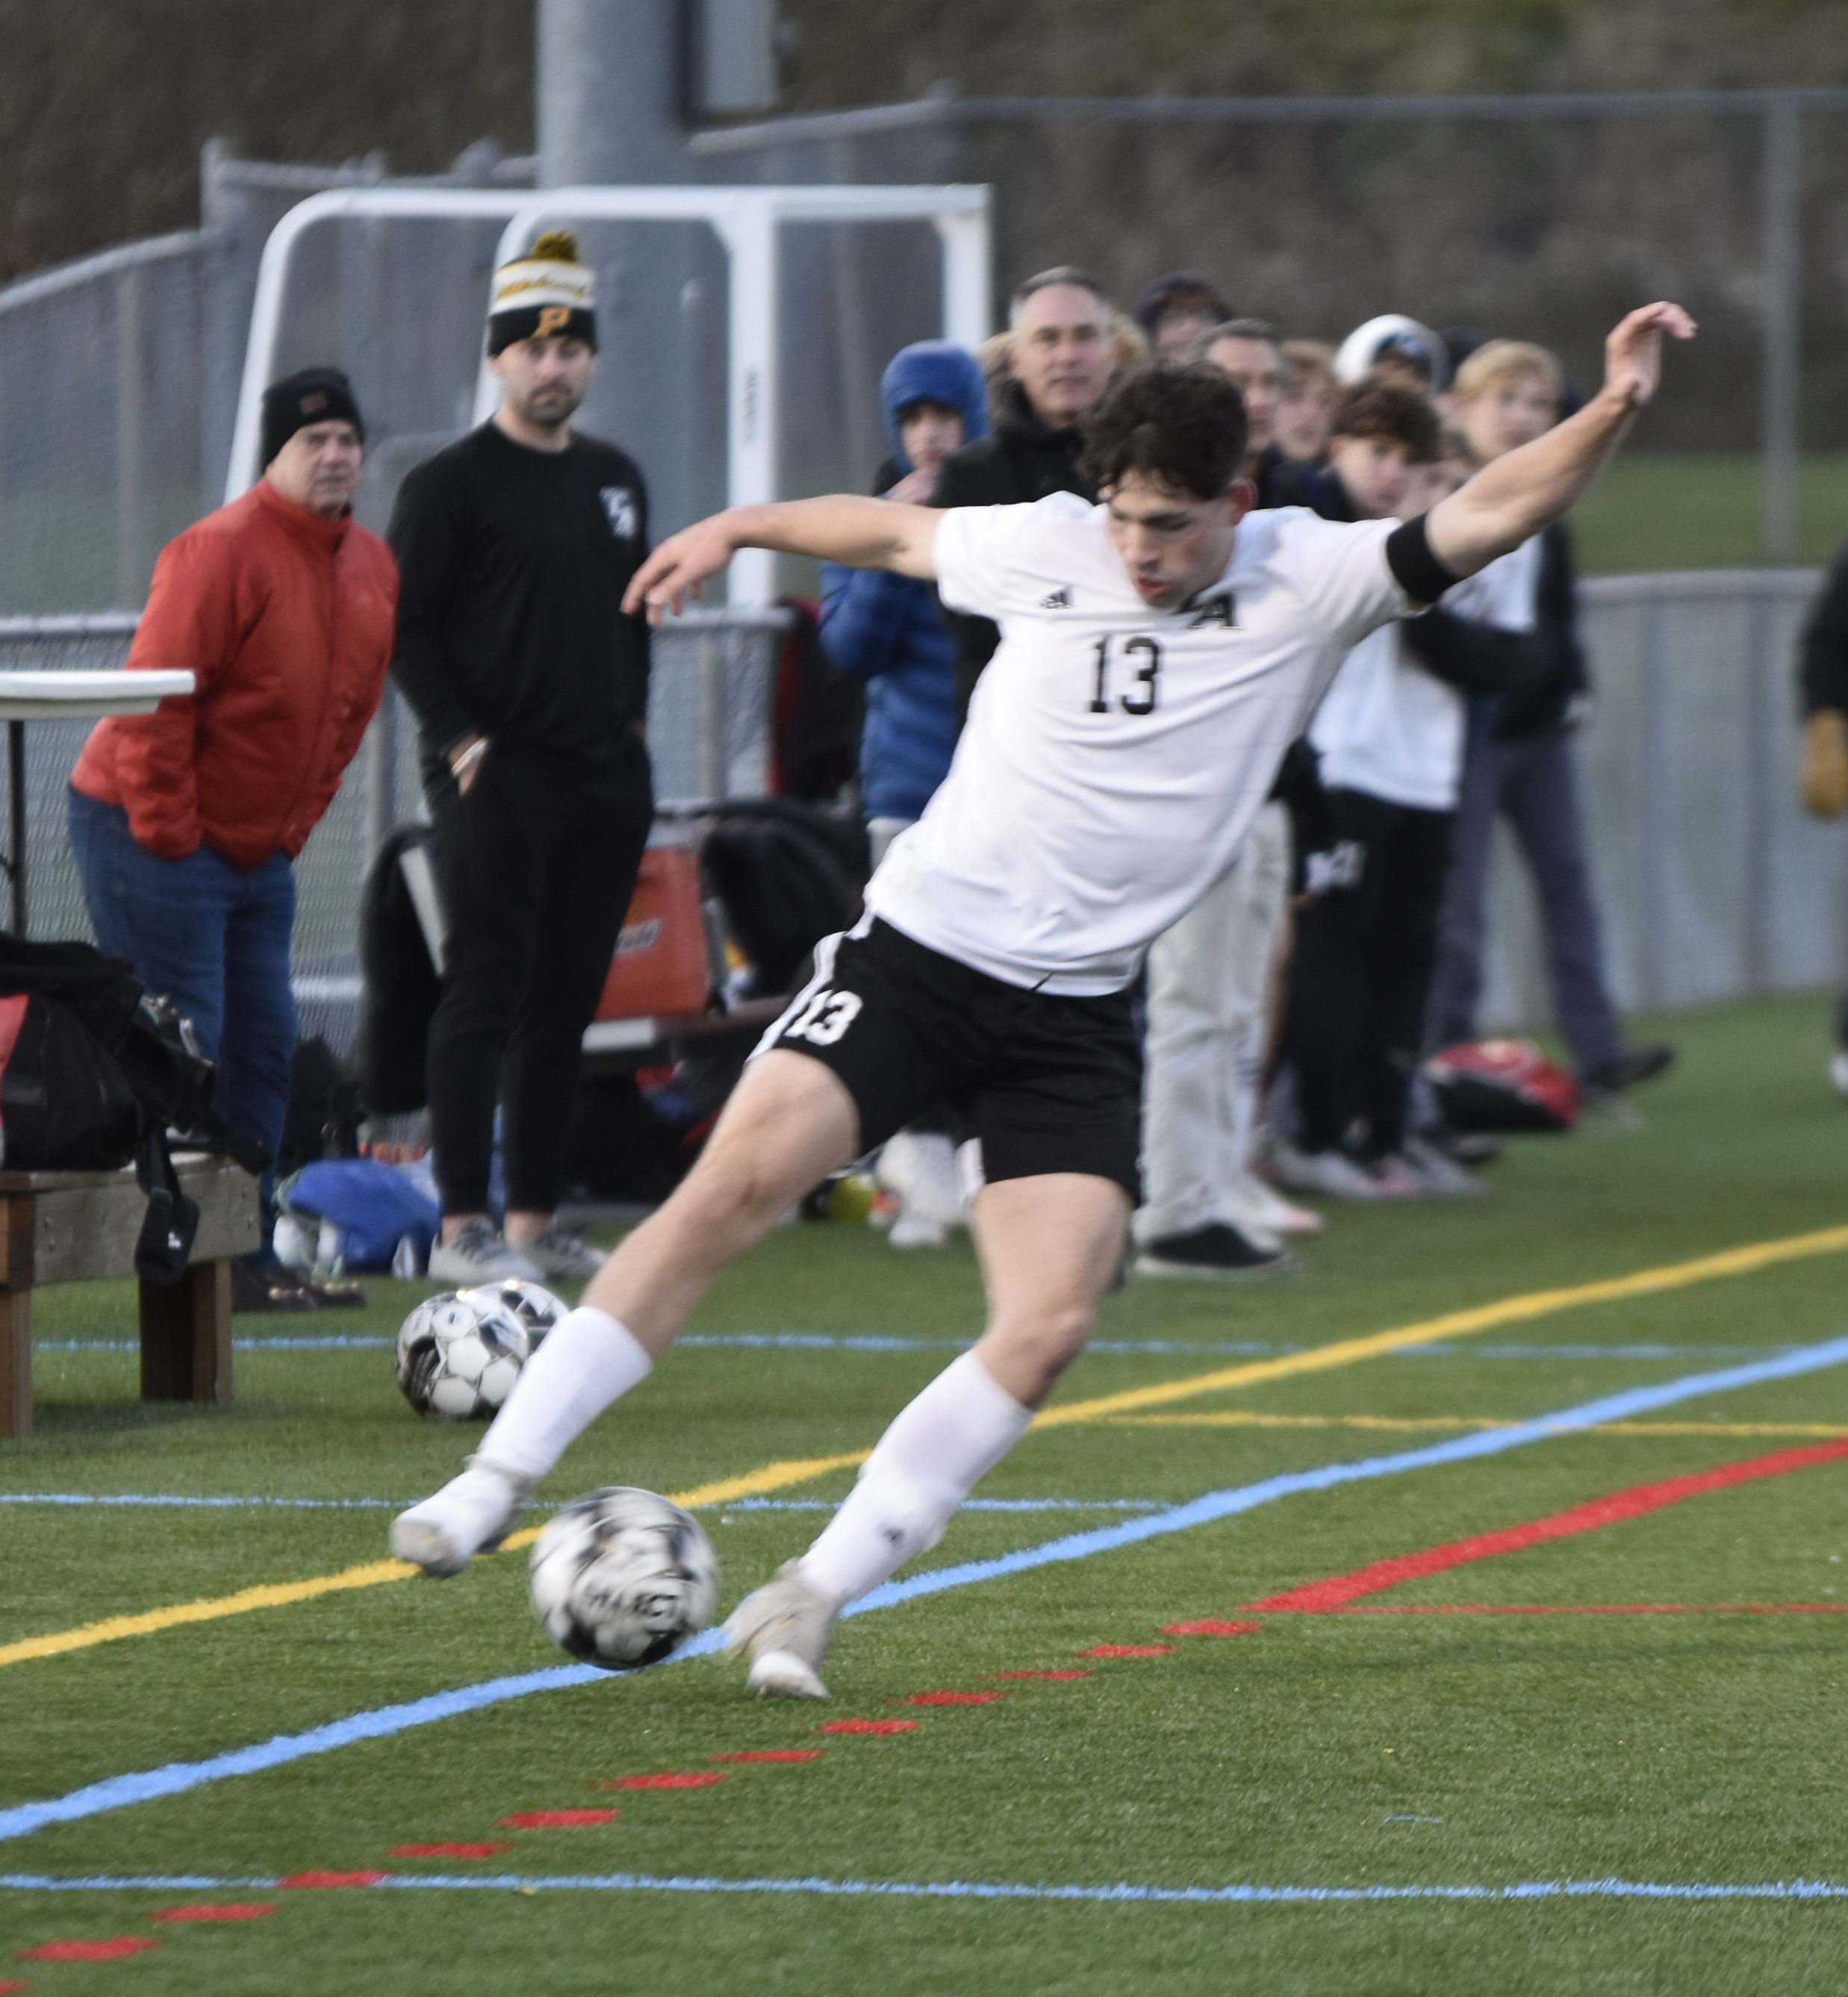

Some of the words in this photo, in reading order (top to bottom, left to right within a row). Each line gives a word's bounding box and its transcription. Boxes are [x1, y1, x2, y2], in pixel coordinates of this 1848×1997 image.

[532, 306, 571, 337] P
[1089, 634, 1160, 714] 13
[784, 989, 863, 1046] 13
